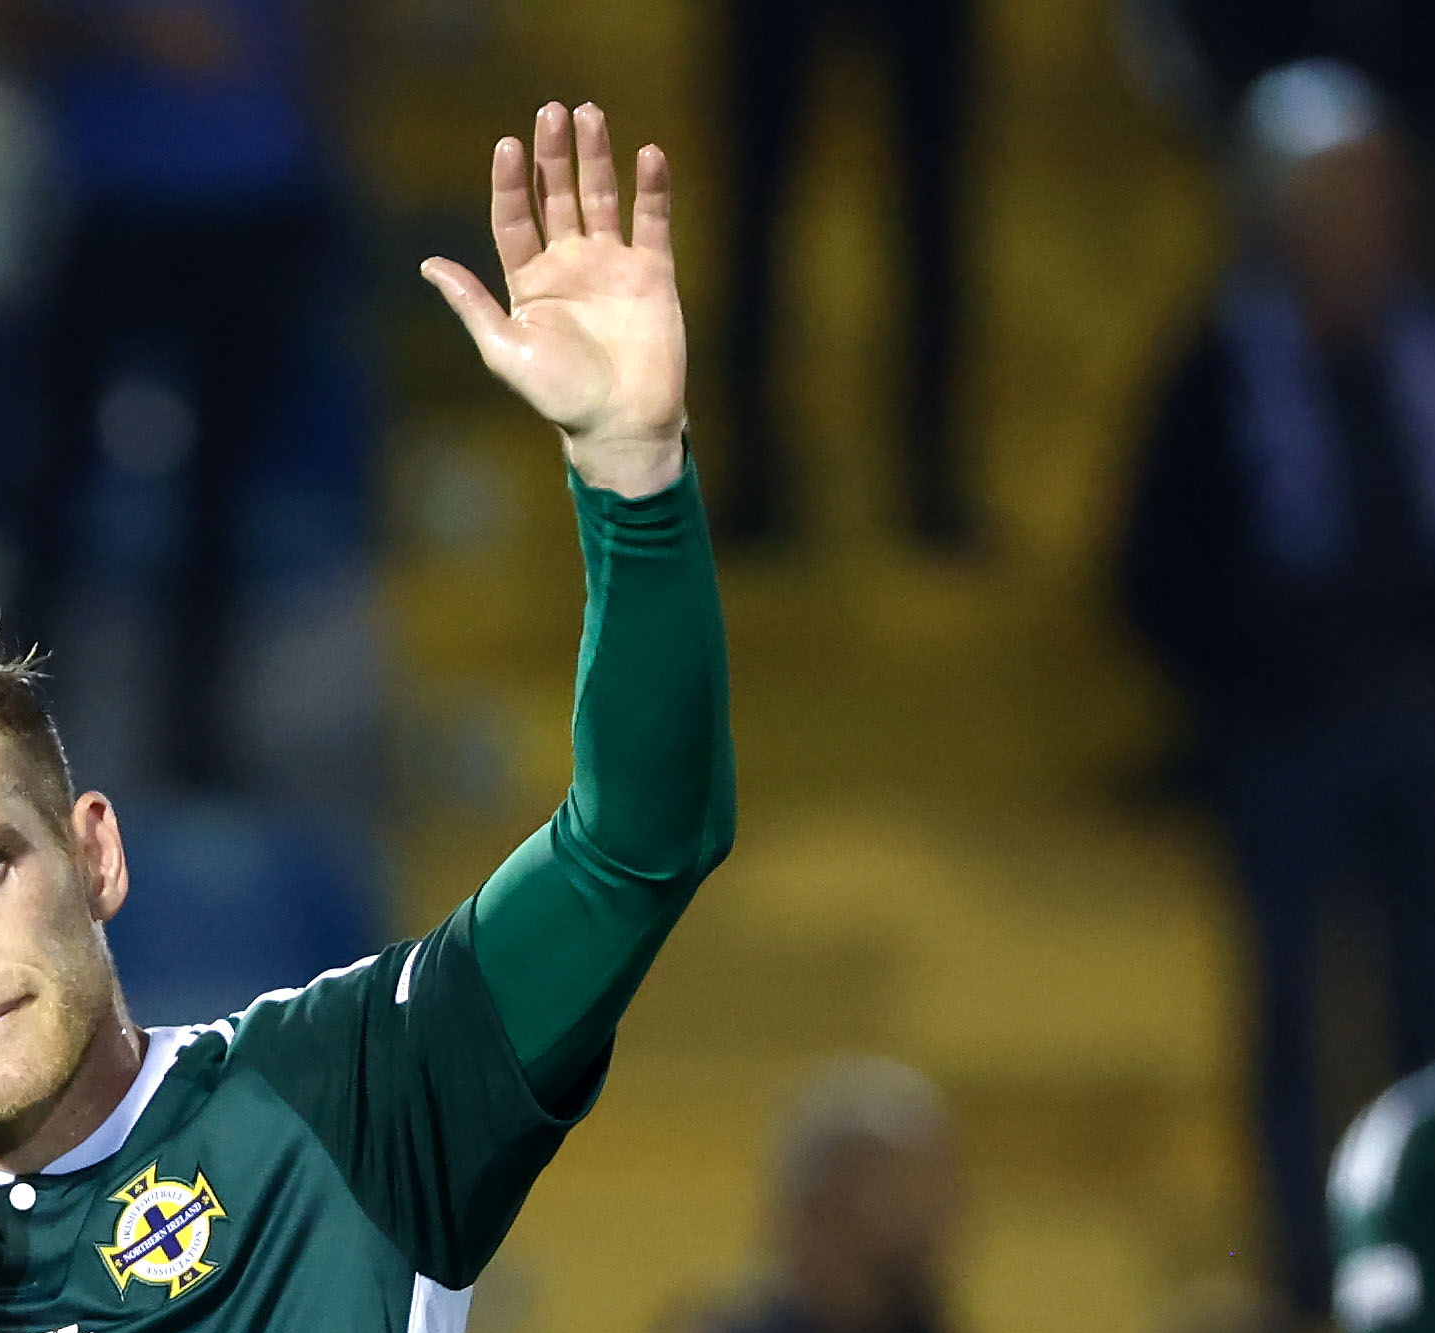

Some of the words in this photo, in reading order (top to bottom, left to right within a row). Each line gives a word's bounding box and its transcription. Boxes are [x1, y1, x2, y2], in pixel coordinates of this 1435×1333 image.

[122, 1208, 138, 1240] IRISH
[135, 1188, 184, 1213] FOOTBALL
[122, 1226, 168, 1263] NORTHERN
[165, 1200, 203, 1234] IRELAND
[145, 1230, 203, 1277] ASSOCIATION
